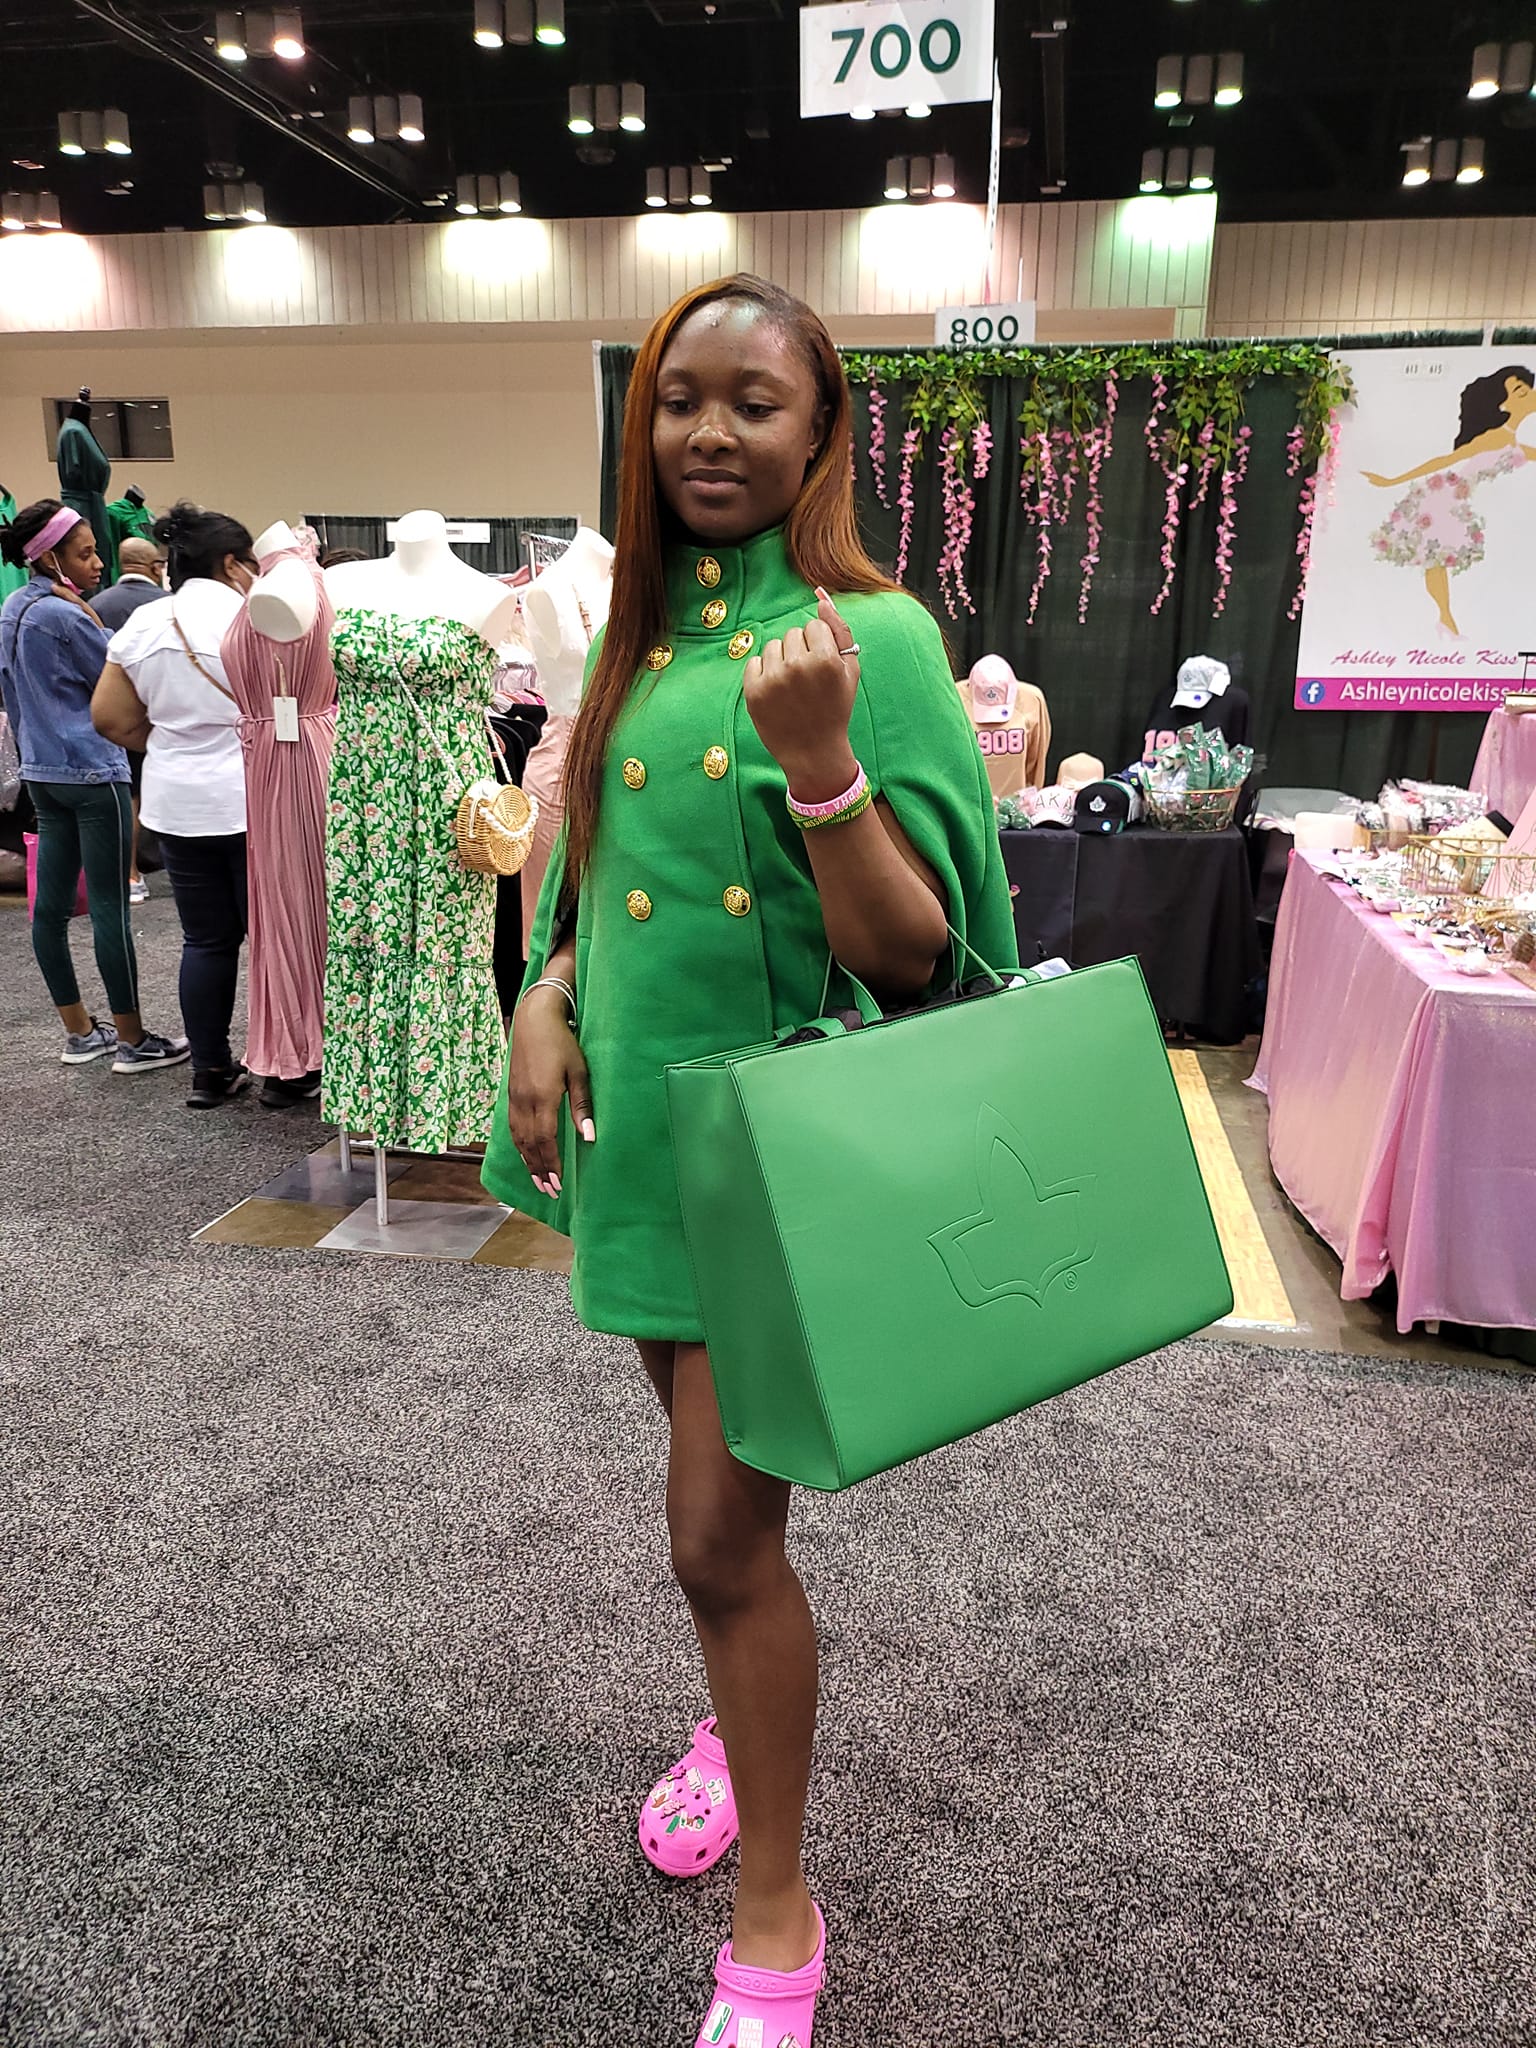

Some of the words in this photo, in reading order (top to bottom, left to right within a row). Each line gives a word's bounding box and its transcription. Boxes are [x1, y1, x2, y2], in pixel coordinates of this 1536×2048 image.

[831, 19, 961, 84] 700
[950, 315, 1019, 344] 800
[1330, 649, 1397, 668] Ashley
[1406, 649, 1466, 666] Nicole
[1476, 650, 1519, 666] Kiss
[975, 728, 1025, 756] 908
